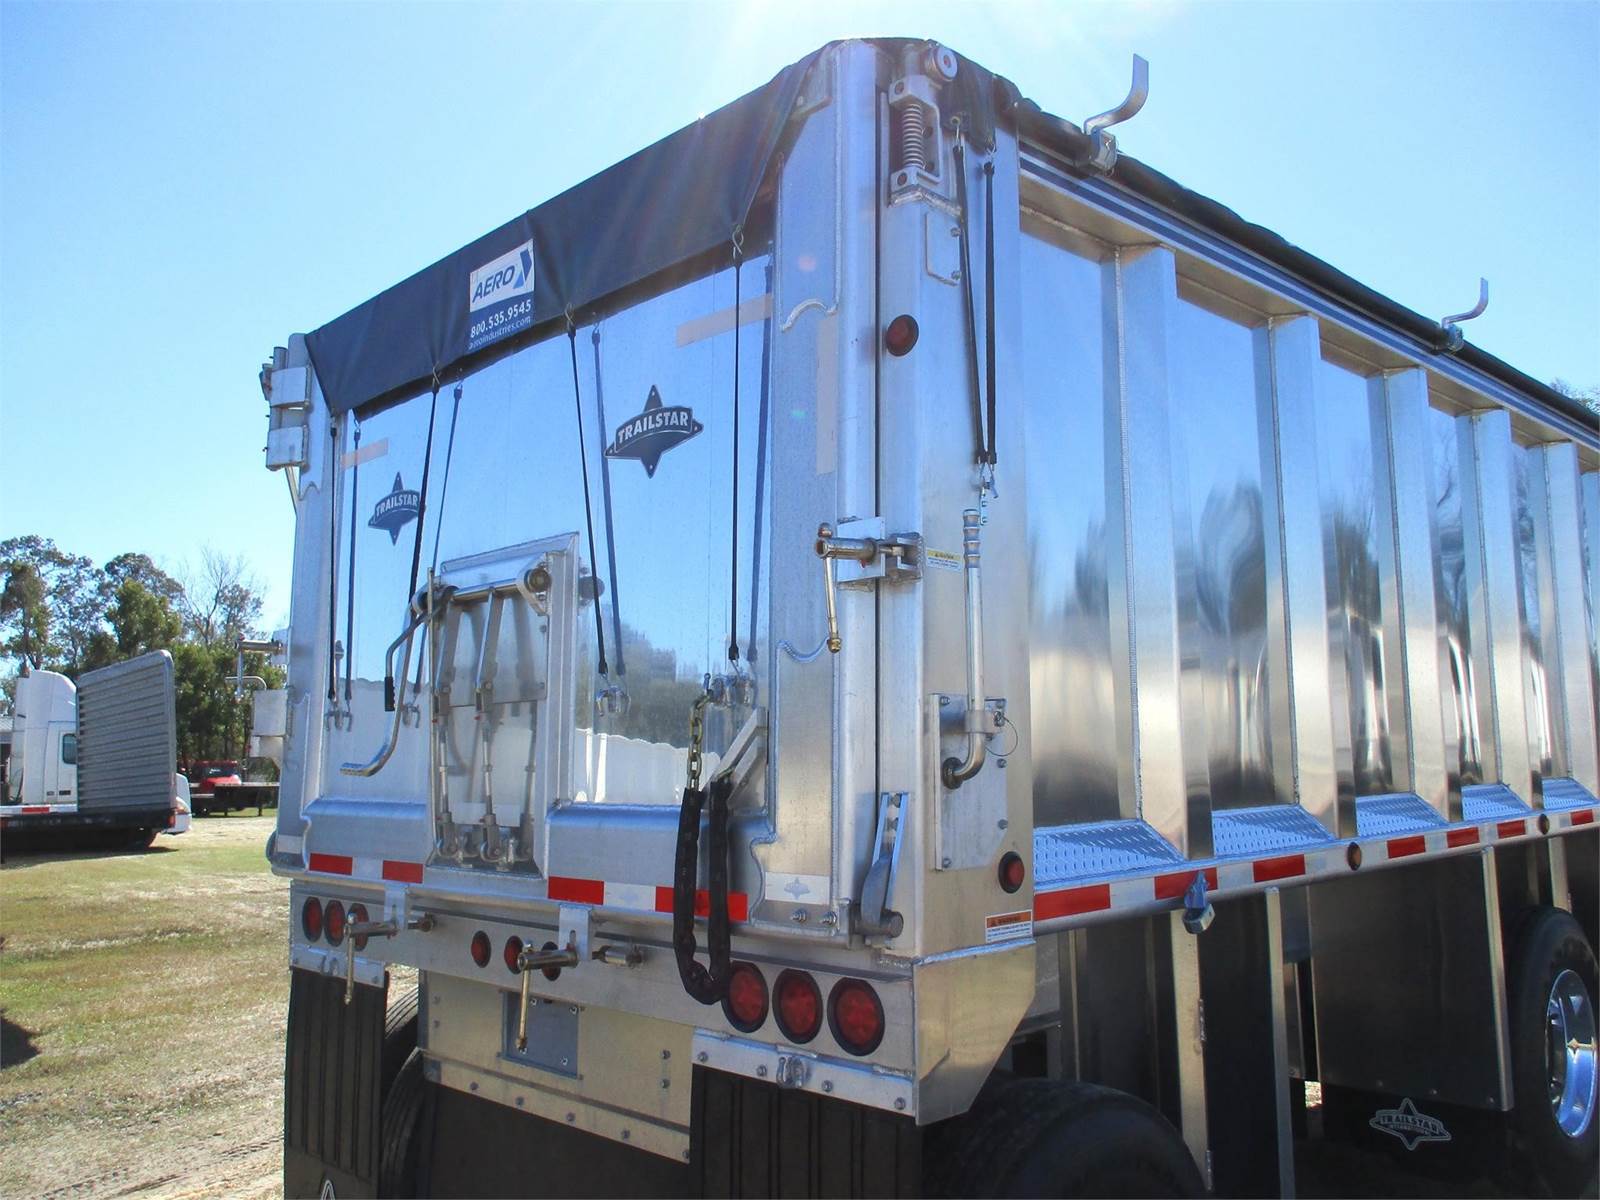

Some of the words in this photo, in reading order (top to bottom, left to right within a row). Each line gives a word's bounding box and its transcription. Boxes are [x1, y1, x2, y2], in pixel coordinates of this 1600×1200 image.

[472, 265, 515, 303] AERO
[470, 299, 532, 339] 800.535.9545
[617, 410, 689, 445] TRAILSTAR
[376, 494, 418, 517] TRAILSTAR
